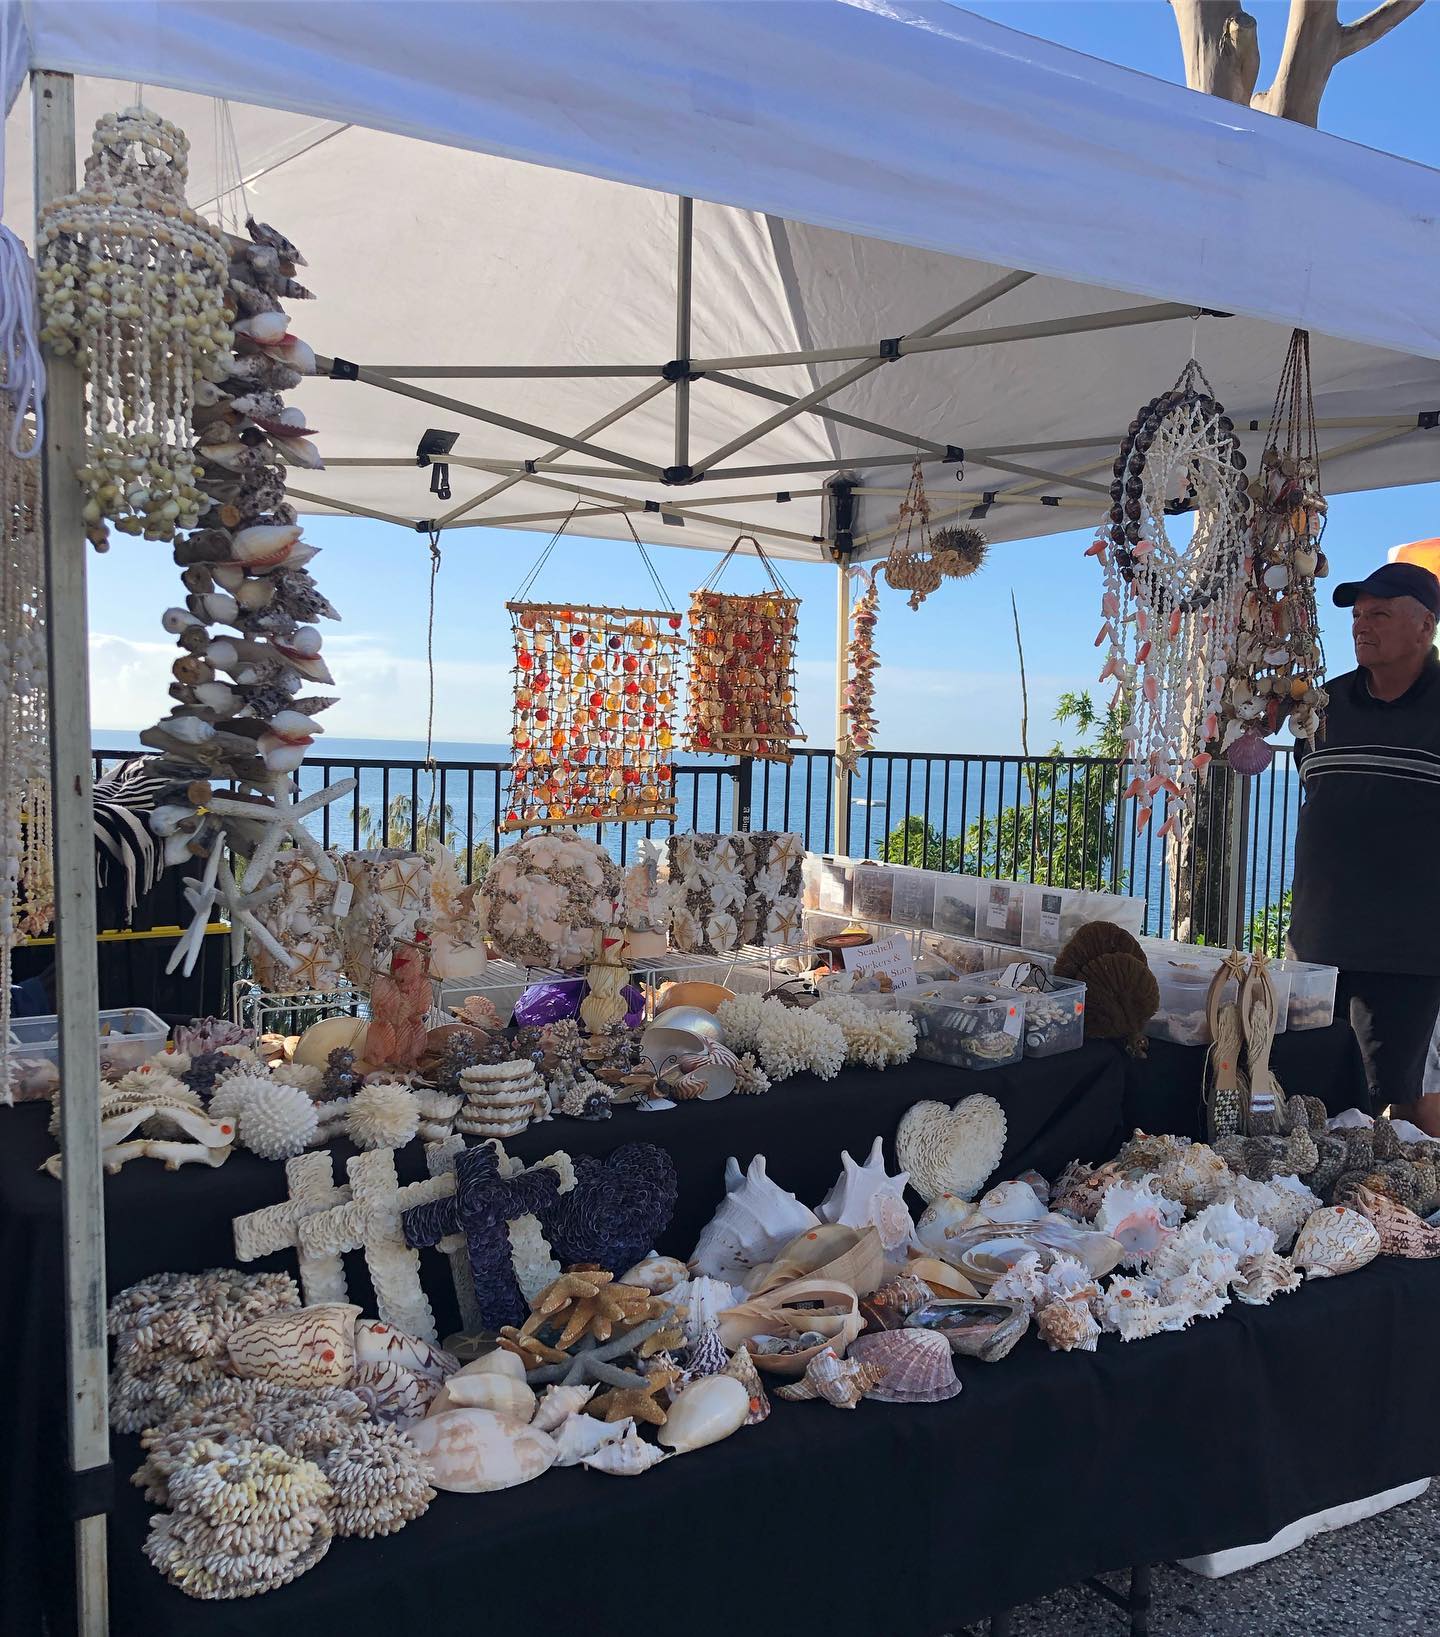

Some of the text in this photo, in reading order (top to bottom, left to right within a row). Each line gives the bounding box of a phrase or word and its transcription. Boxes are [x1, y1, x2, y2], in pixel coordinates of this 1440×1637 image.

[858, 940, 893, 956] Seashell
[892, 953, 902, 962] &
[890, 966, 912, 977] Stars
